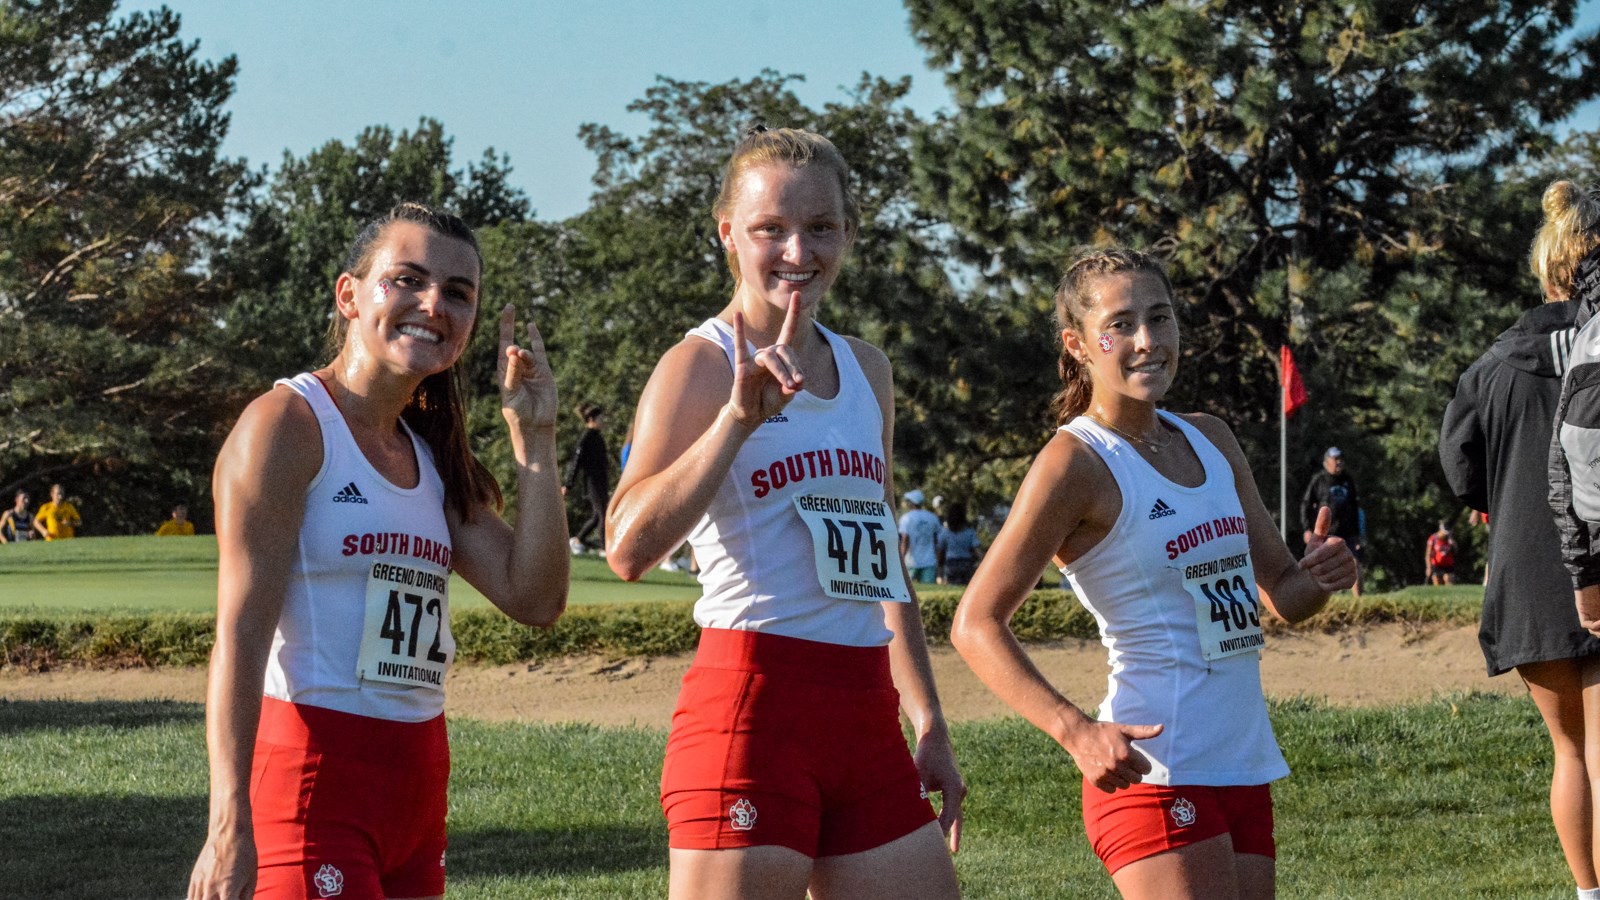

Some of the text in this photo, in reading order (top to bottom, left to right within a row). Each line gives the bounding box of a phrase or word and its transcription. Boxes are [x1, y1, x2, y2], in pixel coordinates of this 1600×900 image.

[763, 415, 788, 424] didas
[751, 448, 885, 499] SOUTH DAKO
[333, 494, 368, 505] adidas
[800, 496, 886, 517] GREENO/DIRKSEN
[1148, 508, 1177, 520] adidas
[342, 532, 451, 569] SOUTH DAKO
[822, 517, 888, 581] 475
[1165, 516, 1248, 561] SOUTH DAKO
[830, 579, 895, 599] INVITATIONAL
[1200, 574, 1260, 633] 483
[380, 589, 447, 663] 472
[377, 661, 441, 686] INVITATIONAL
